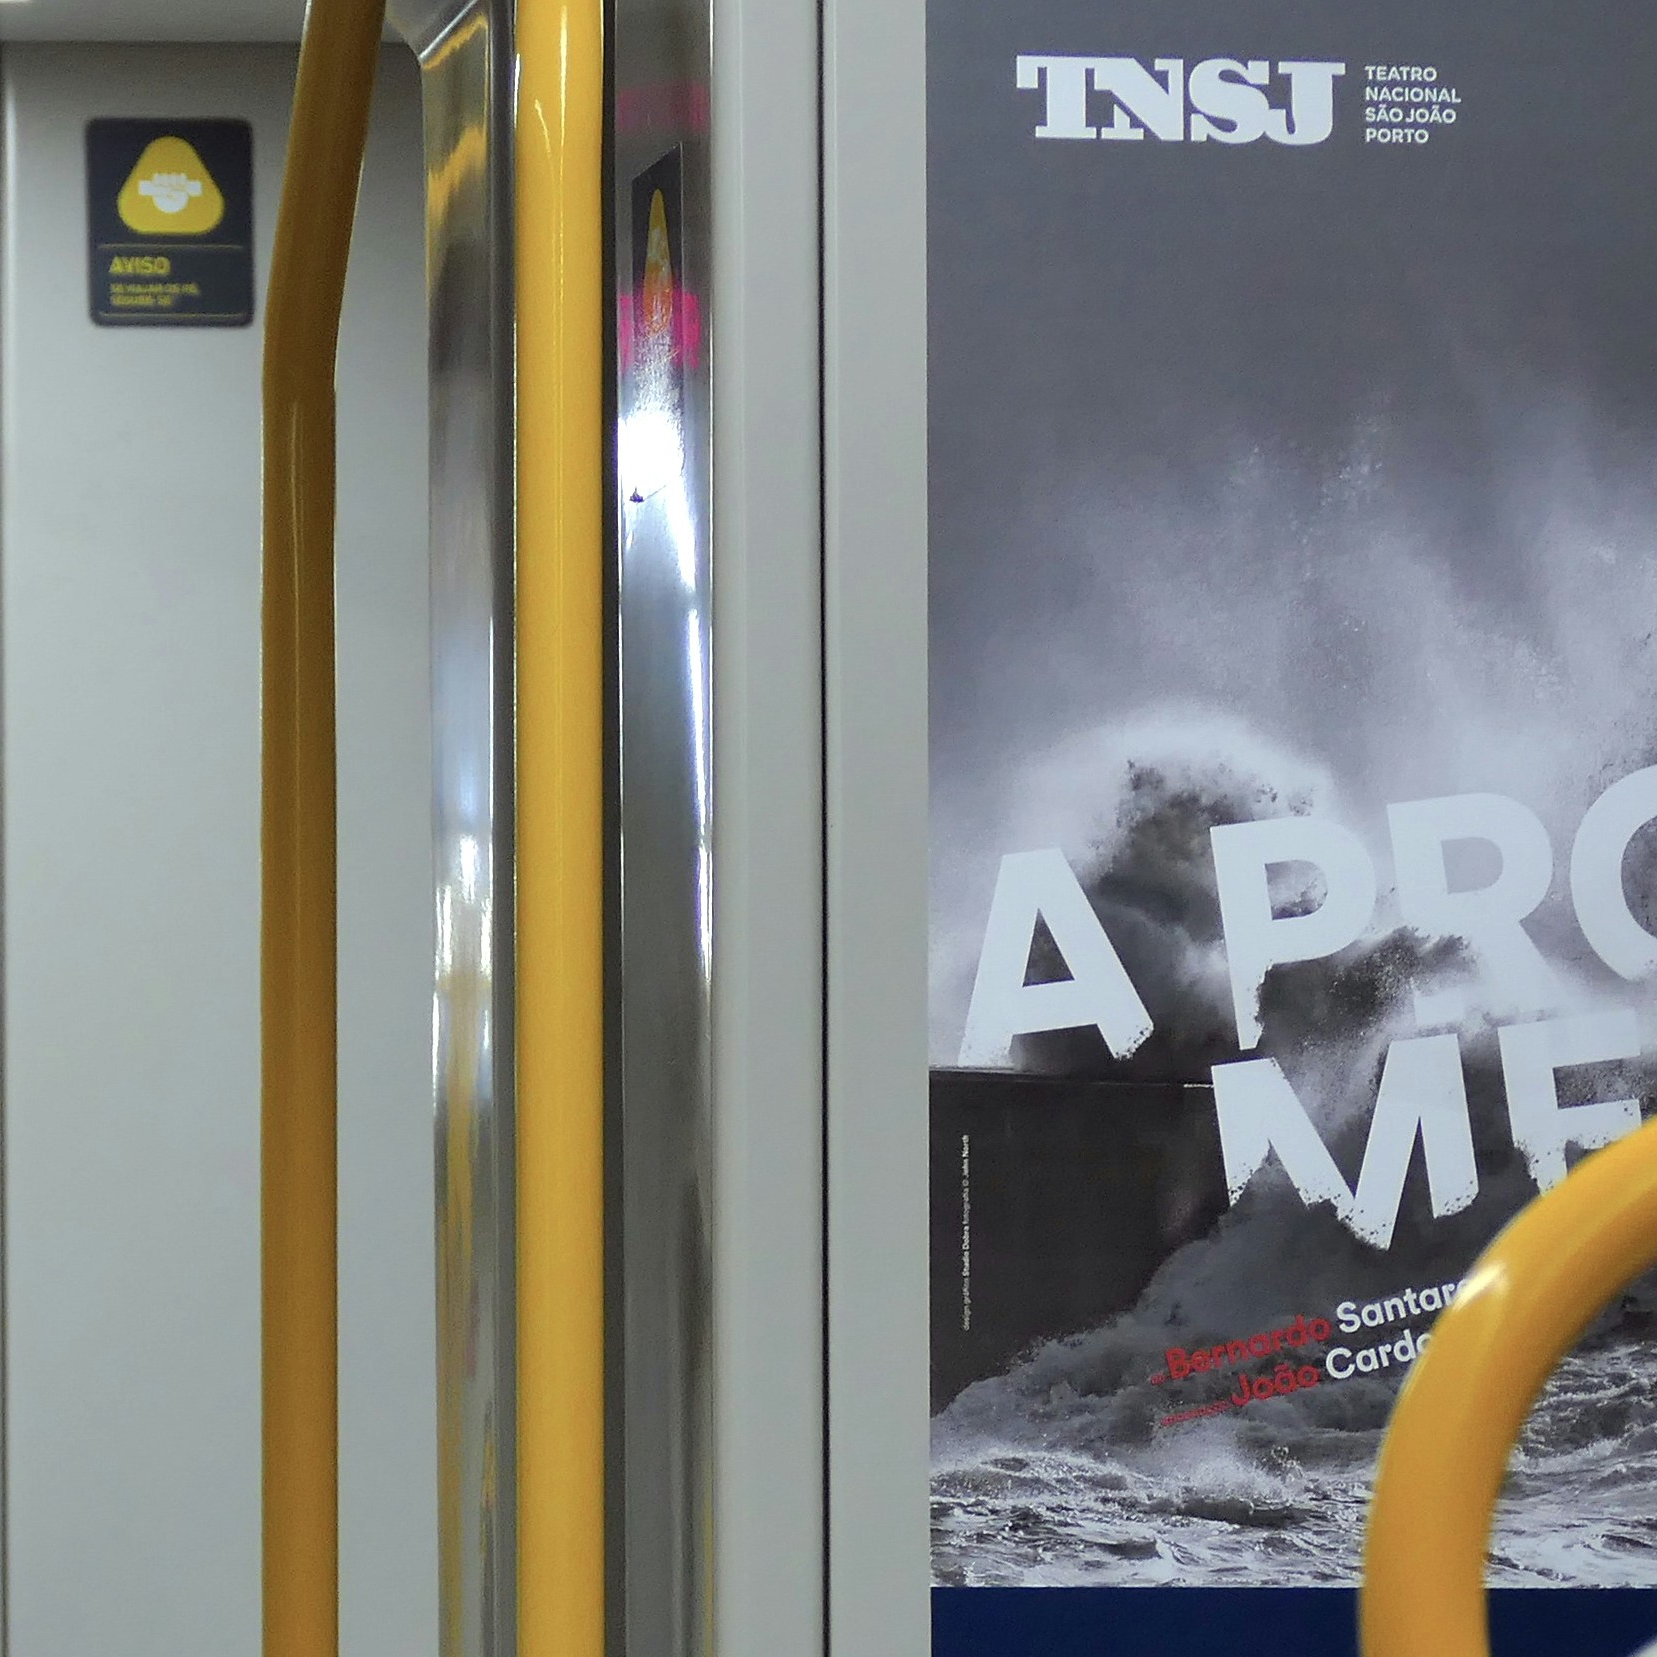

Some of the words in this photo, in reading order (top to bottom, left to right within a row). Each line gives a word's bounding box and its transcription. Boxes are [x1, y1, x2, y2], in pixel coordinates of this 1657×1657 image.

[1365, 66, 1438, 82] TEATRO
[1016, 55, 1346, 145] TNSJ
[1365, 86, 1461, 104] NACIONAL
[1365, 104, 1403, 124] SÃO
[1405, 104, 1457, 124] JOÃO
[1365, 127, 1429, 144] PORTO
[109, 256, 172, 276] AVISO
[958, 847, 1155, 1067] A
[1166, 1313, 1332, 1380] Bernardo
[1336, 1278, 1468, 1333] Santar
[1231, 1362, 1319, 1406] João
